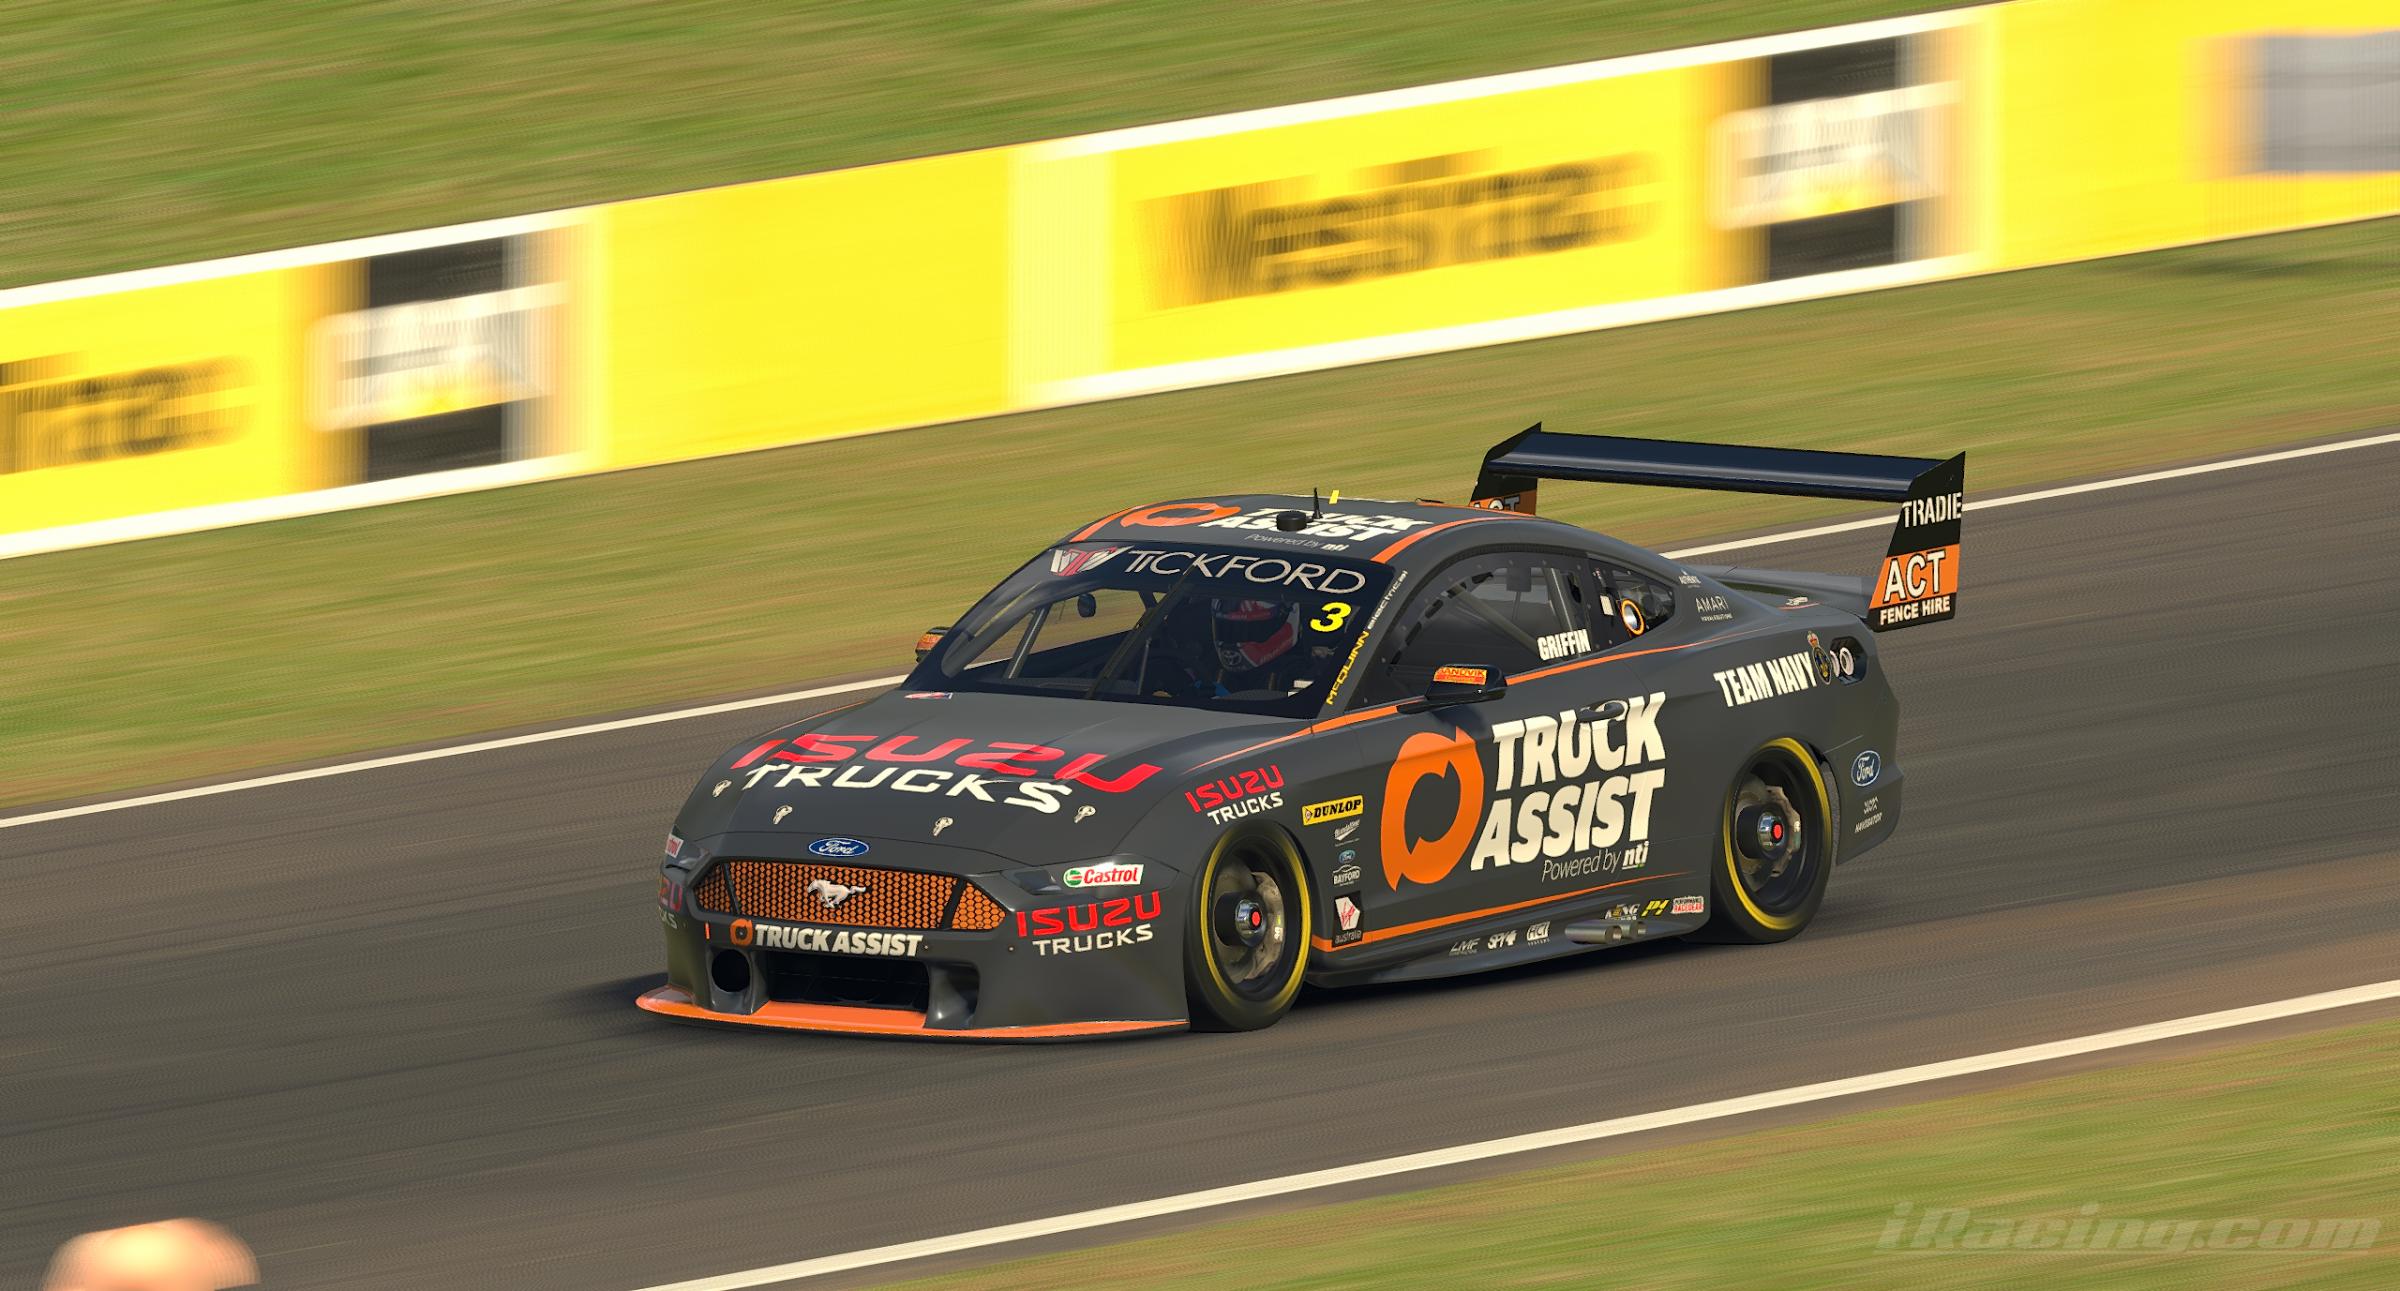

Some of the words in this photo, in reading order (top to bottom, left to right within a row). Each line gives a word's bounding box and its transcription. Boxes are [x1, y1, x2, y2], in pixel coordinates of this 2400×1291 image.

[1246, 508, 1434, 531] TUCK
[1902, 492, 1962, 528] TRADIE
[1198, 515, 1401, 542] ASIST
[1245, 534, 1304, 546] Powered
[1306, 539, 1325, 550] by
[1883, 550, 1946, 604] ACT
[1310, 602, 1352, 633] 3
[1695, 596, 1729, 613] AMARI
[1880, 601, 1919, 626] FENCE
[1922, 596, 1951, 617] HIRE
[1537, 629, 1591, 661] GRIFFIN
[1713, 662, 1774, 708] TEAM
[1766, 651, 1818, 695] NAVY
[1492, 692, 1666, 791] TRUCK
[730, 733, 1163, 793] ISUZU
[741, 763, 1073, 814] TRUCKS
[1185, 764, 1285, 813] ISUZU
[1207, 791, 1284, 825] TRUCKS
[1314, 799, 1361, 818] DUNLOP
[1471, 768, 1666, 871] ASSIST
[817, 840, 860, 856] Ford
[1542, 849, 1601, 882] Powered
[1603, 848, 1622, 874] by
[1622, 840, 1650, 868] nti
[1084, 867, 1138, 885] Castrol
[1016, 891, 1161, 937] ISUZU
[754, 923, 834, 951] TRUCK
[831, 930, 923, 957] ASSIST
[1032, 923, 1153, 956] TRUCKS
[1335, 930, 1362, 944] australia
